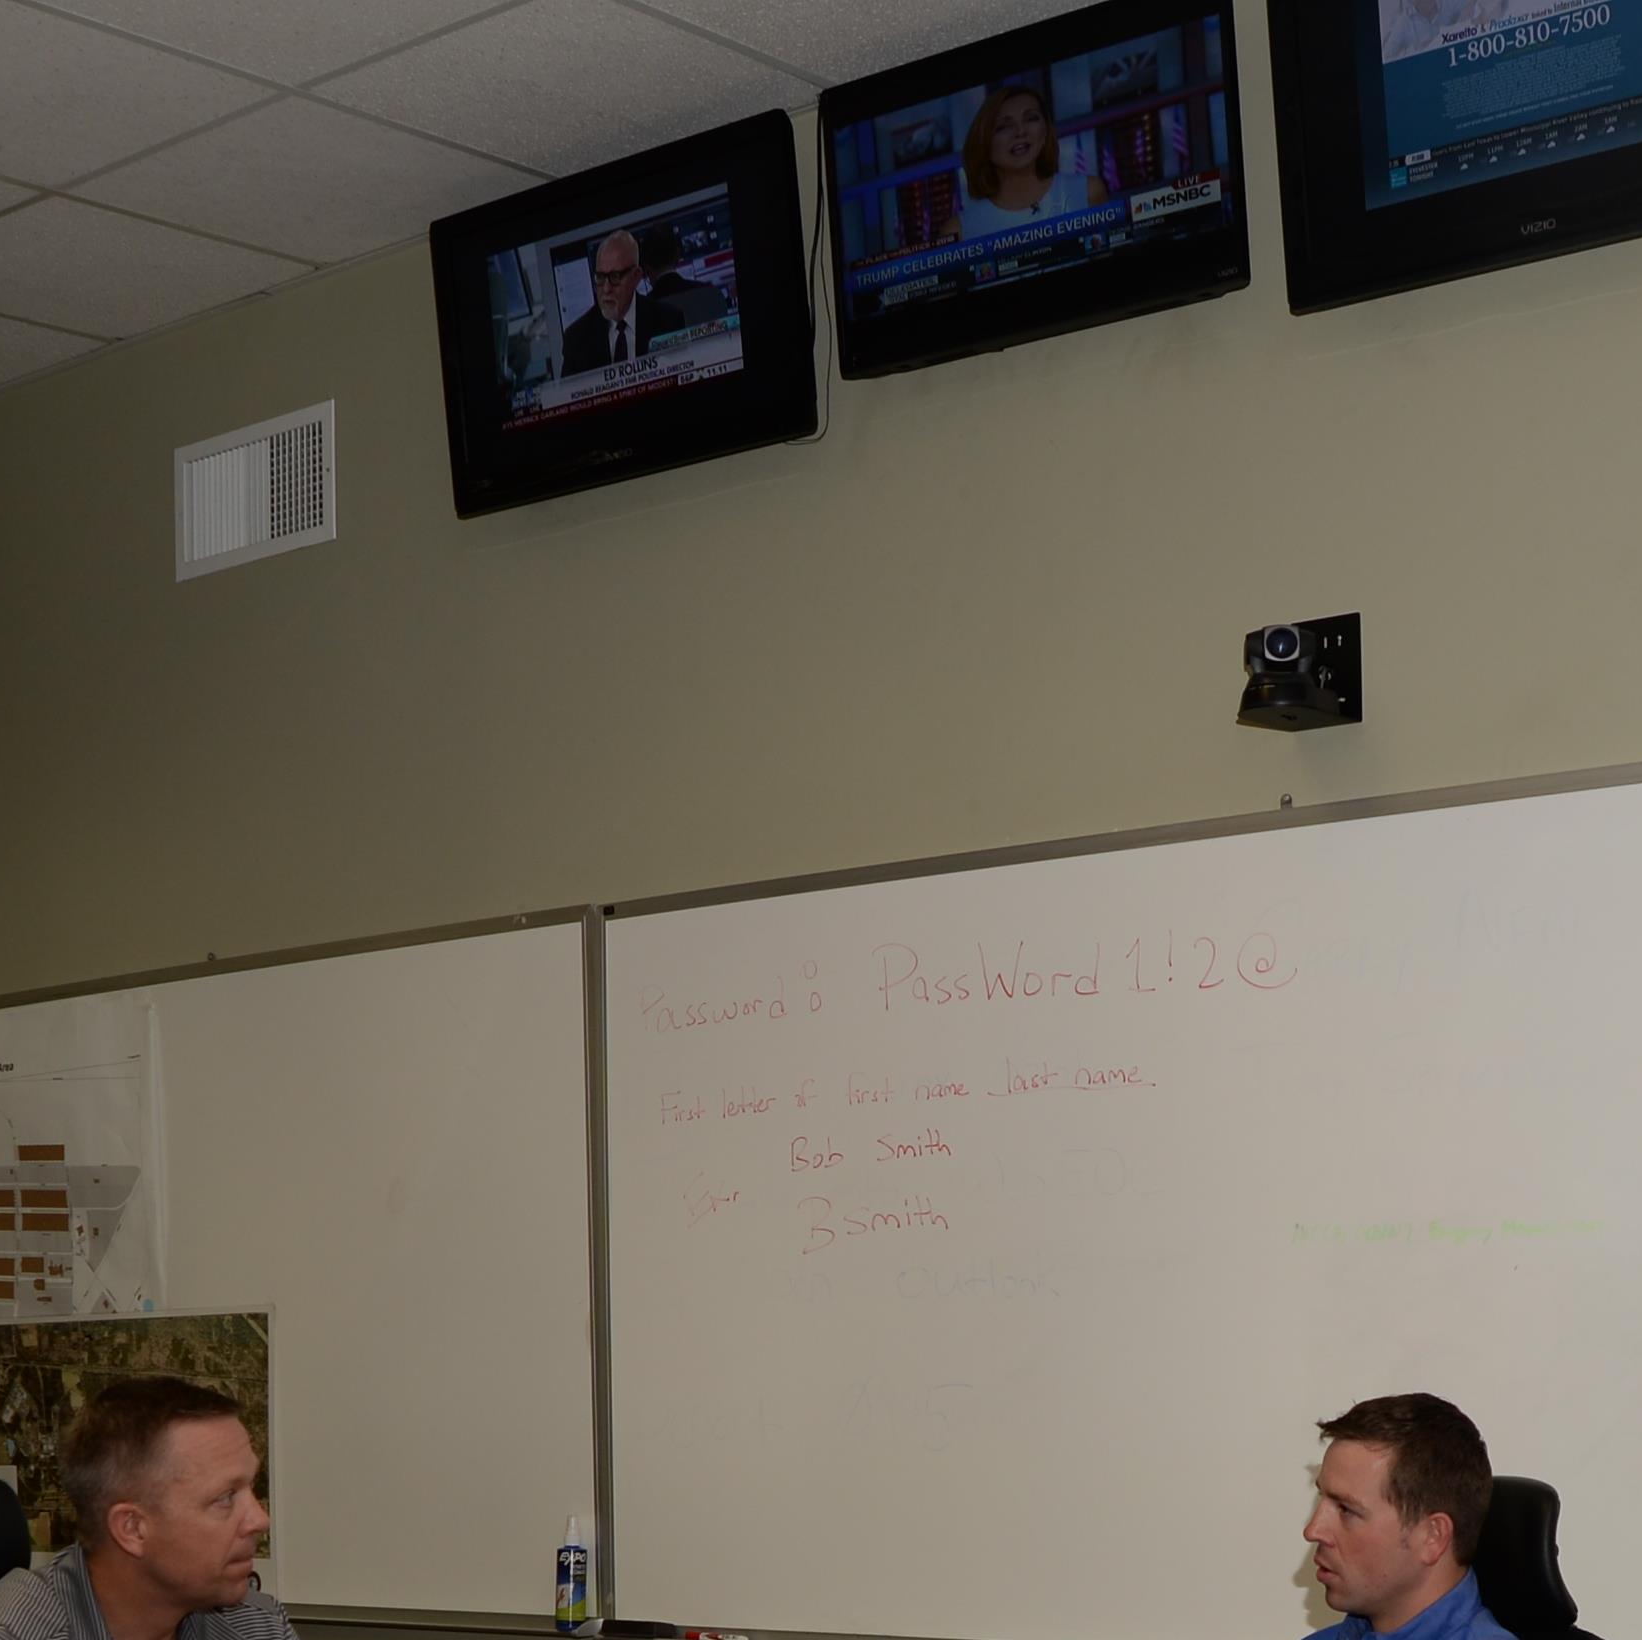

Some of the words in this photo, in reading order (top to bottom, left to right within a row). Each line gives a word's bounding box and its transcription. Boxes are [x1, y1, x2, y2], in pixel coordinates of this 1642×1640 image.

[1442, 26, 1478, 45] Xarelto
[1448, 4, 1611, 68] 1-800-810-7500
[1152, 184, 1211, 209] MSNBC
[1520, 218, 1557, 235] VIZIO
[856, 264, 900, 288] TRUMP
[902, 242, 985, 274] CELEBRATES
[987, 225, 1054, 251] "AMAZING
[1056, 206, 1123, 234] EVENING"
[603, 368, 616, 382] ED
[619, 355, 659, 377] ROLLINS
[660, 1090, 706, 1125] First
[722, 1084, 778, 1119] letter
[846, 1072, 895, 1107] first
[915, 1080, 971, 1101] name
[789, 1135, 845, 1173] Bob
[876, 1127, 953, 1162] Smith
[559, 1550, 587, 1566] EXPO
